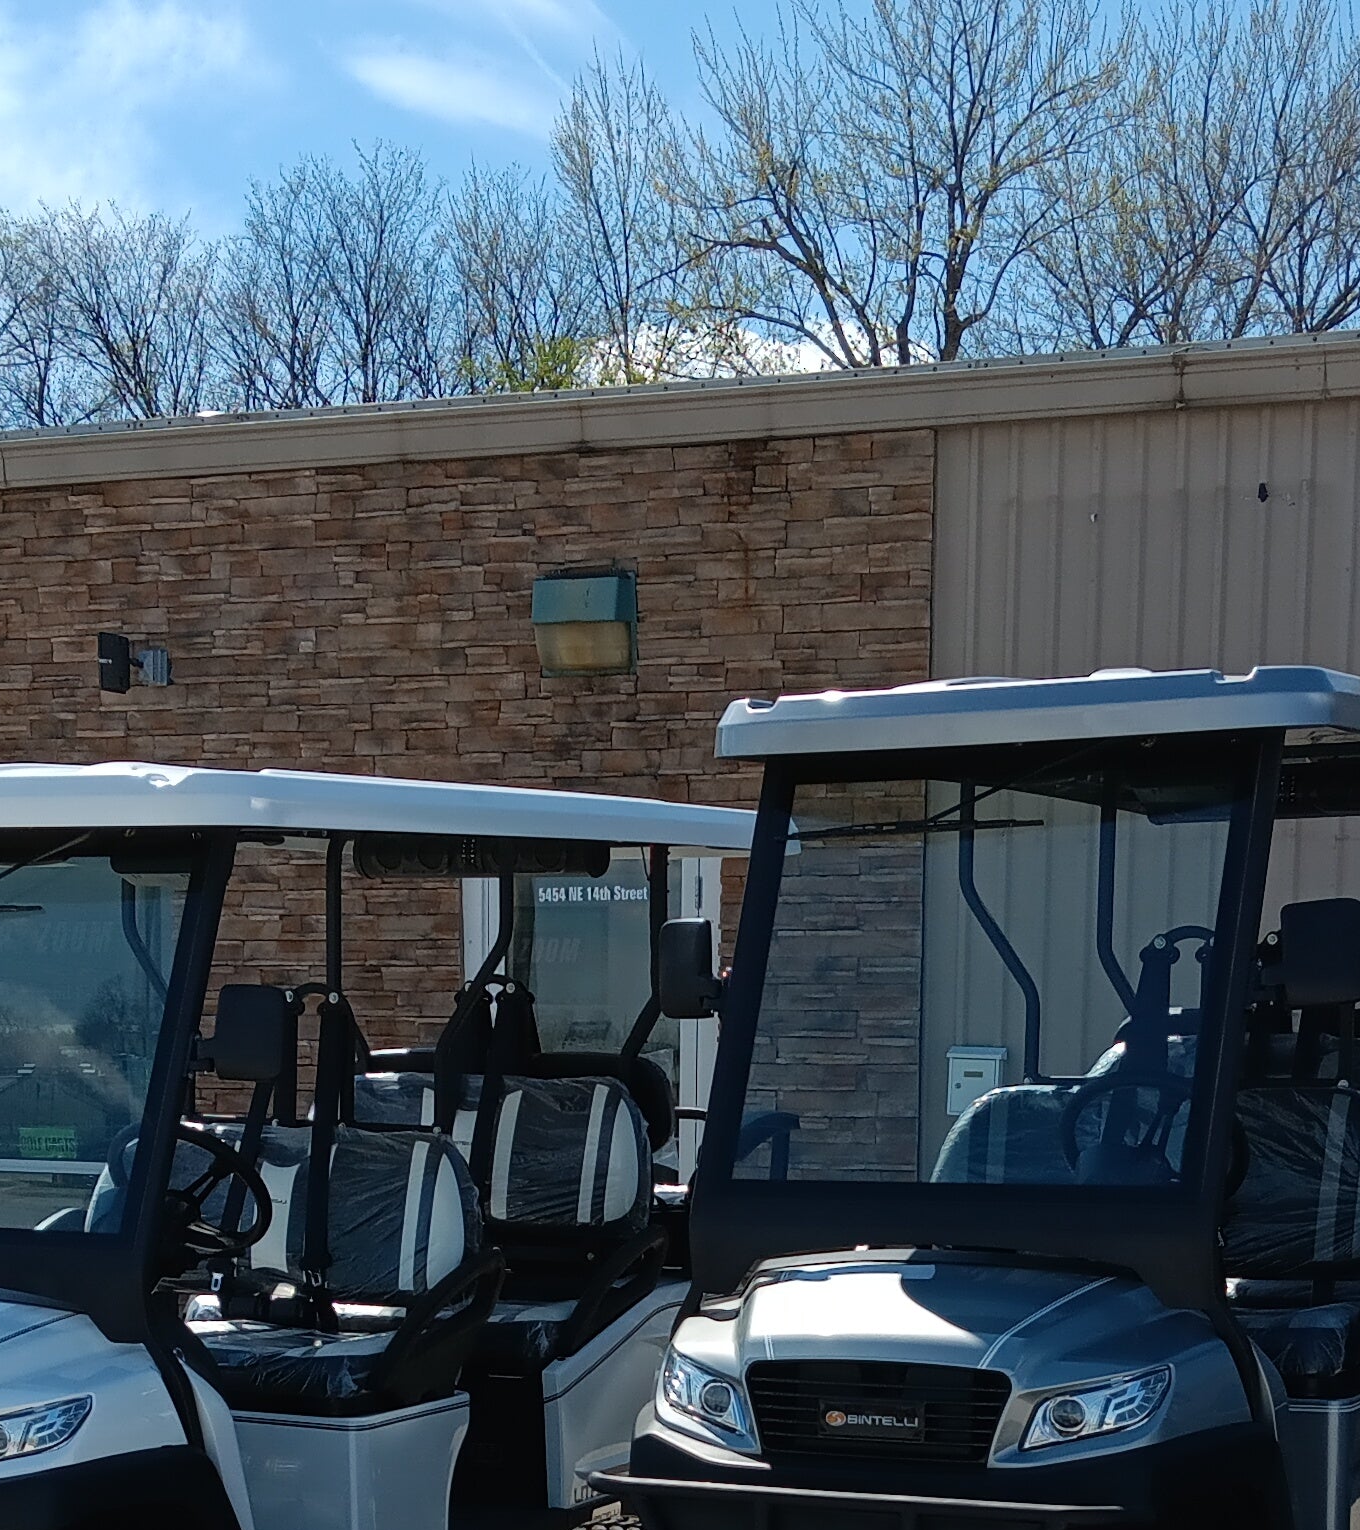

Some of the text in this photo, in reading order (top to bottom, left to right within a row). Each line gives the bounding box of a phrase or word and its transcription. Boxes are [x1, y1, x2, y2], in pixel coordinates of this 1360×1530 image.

[538, 885, 648, 903] 5454 NE 14th Street
[847, 1414, 918, 1427] BINTELLI
